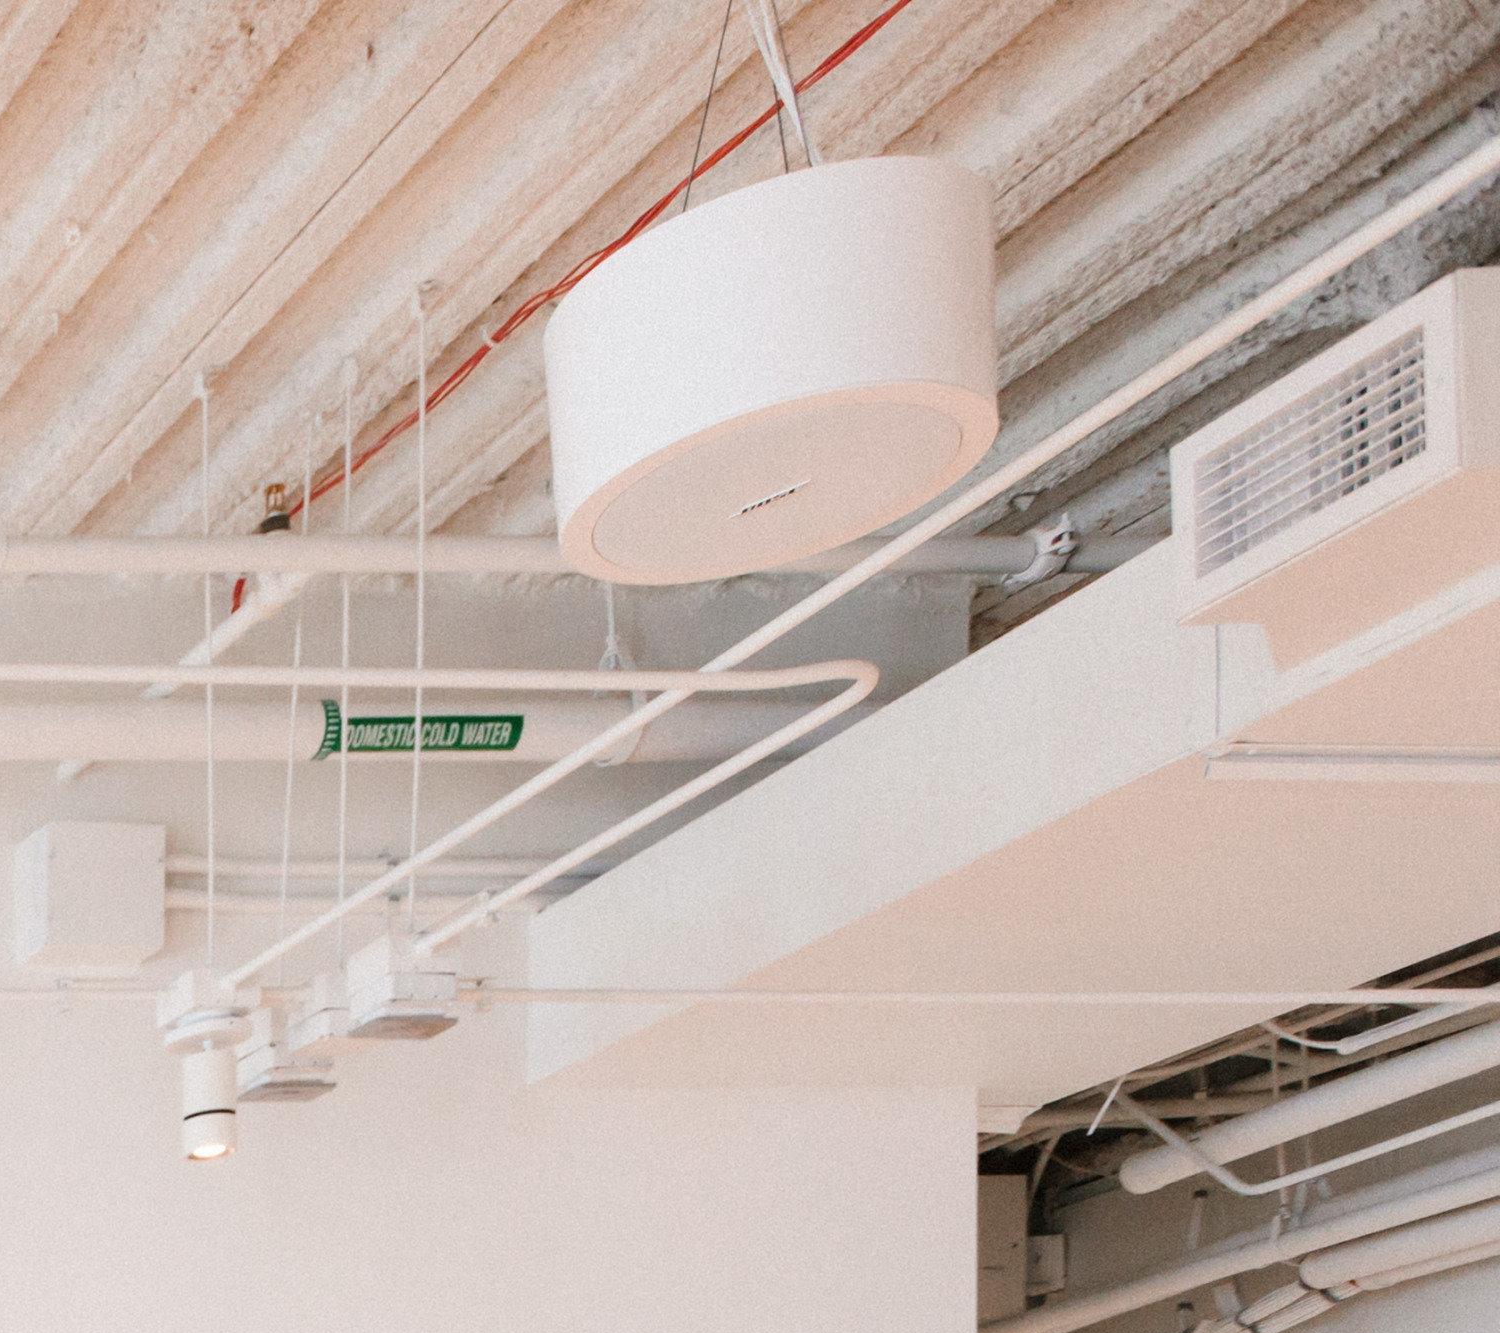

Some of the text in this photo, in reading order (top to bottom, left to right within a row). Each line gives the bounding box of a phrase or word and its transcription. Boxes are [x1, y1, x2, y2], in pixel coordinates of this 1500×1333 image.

[347, 722, 512, 748] DOMESTIC COLD WATER
